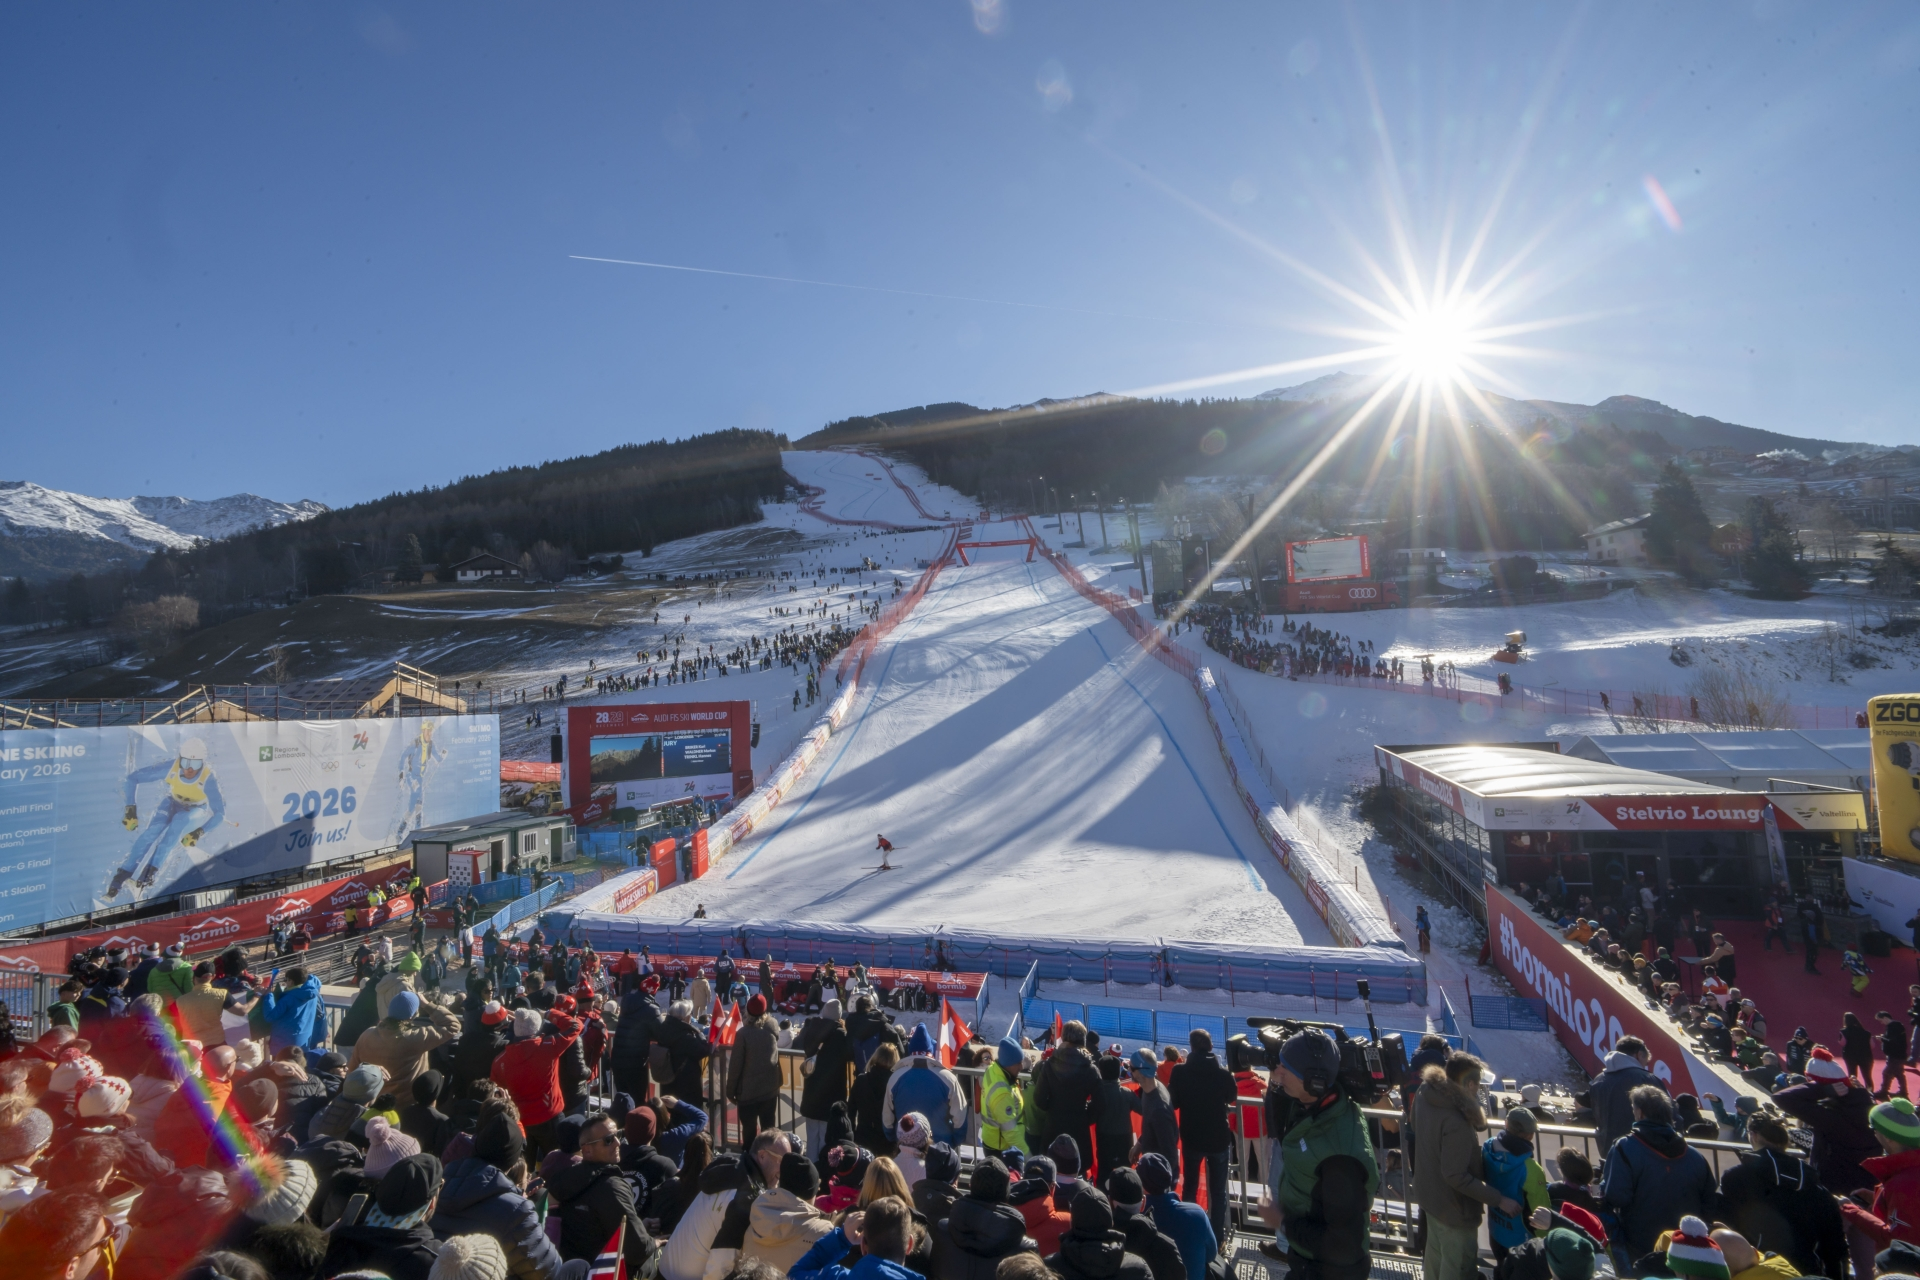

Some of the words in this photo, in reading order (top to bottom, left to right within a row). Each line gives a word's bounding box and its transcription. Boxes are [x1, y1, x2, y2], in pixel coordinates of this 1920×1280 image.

[654, 714, 668, 722] AUDI
[670, 713, 679, 722] FIS
[680, 713, 690, 721] SKI
[690, 712, 713, 720] WORLD
[714, 711, 728, 720] CUP
[23, 744, 86, 760] SKIING
[274, 751, 306, 759] Lombardia
[33, 762, 71, 777] 2026
[30, 802, 54, 812] Final
[283, 785, 357, 823] 2026
[1616, 806, 1687, 821] Stelvio
[1819, 810, 1857, 818] Valtellina
[15, 824, 68, 838] Combined
[285, 826, 323, 852] Join
[326, 819, 352, 843] us!
[28, 857, 51, 869] Final
[11, 883, 46, 896] Slalom
[331, 884, 370, 906] bormio
[266, 902, 313, 925] bormio
[180, 921, 241, 943] bormio
[937, 982, 967, 990] bormio
